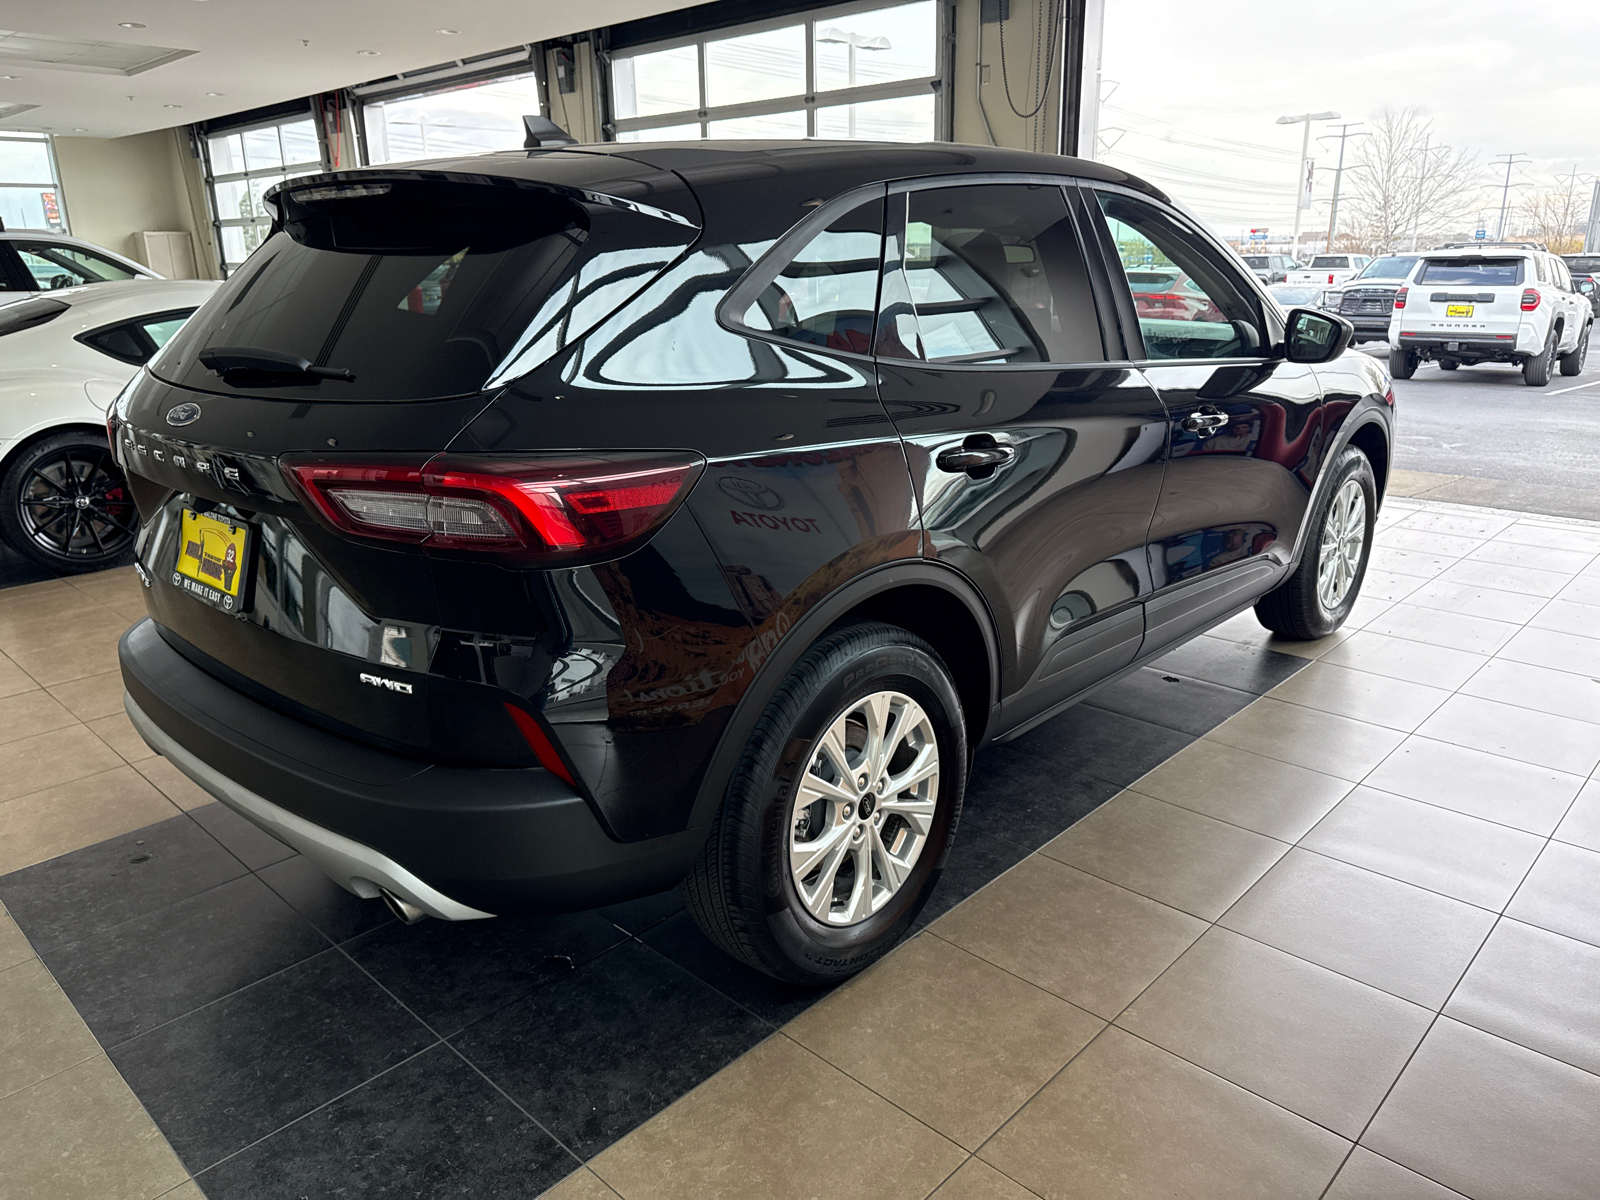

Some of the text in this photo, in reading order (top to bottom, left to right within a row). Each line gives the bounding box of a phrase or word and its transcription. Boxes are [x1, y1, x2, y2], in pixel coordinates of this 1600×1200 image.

[169, 404, 196, 421] Ford
[124, 438, 240, 481] ESCAPE
[226, 549, 235, 562] 32
[183, 578, 221, 603] WE MAKE IT EASY
[359, 672, 413, 694] AWD
